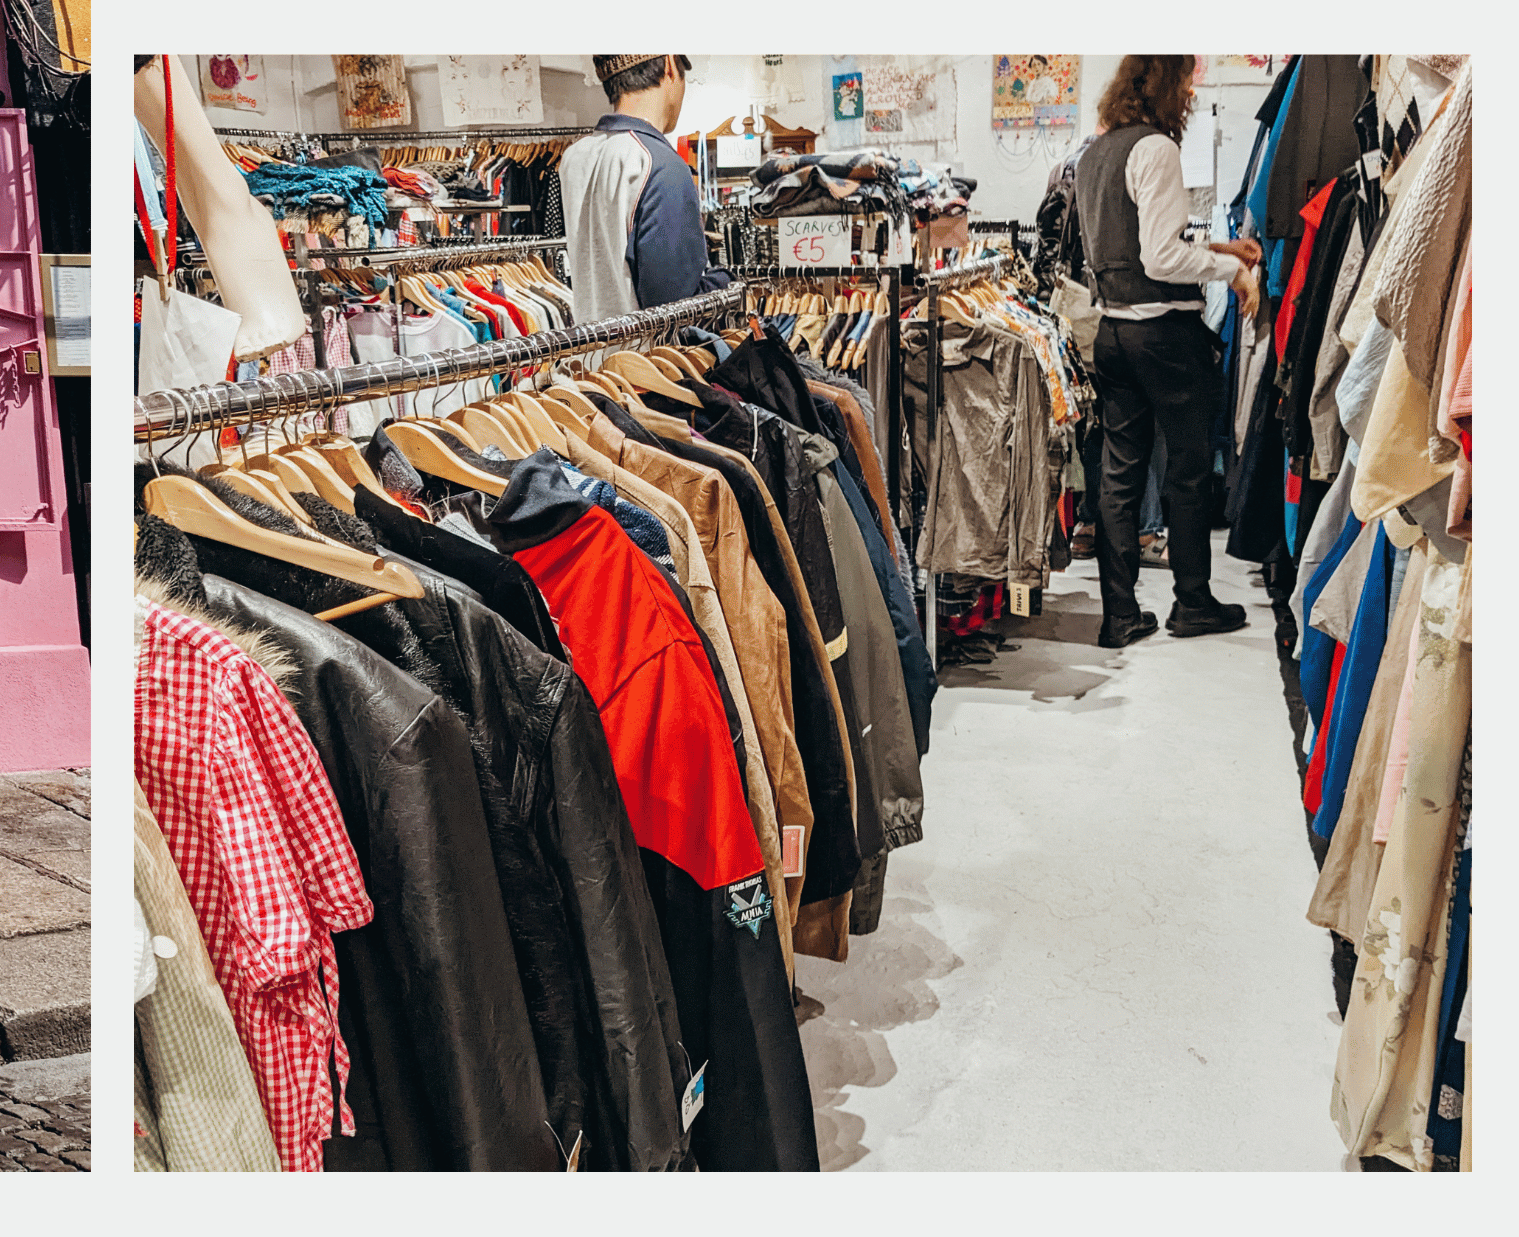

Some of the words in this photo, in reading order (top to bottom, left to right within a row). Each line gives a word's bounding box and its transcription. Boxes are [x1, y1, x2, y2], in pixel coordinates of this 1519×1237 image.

[785, 219, 842, 237] SCARVES
[792, 235, 825, 263] €5
[728, 881, 745, 894] FRANK
